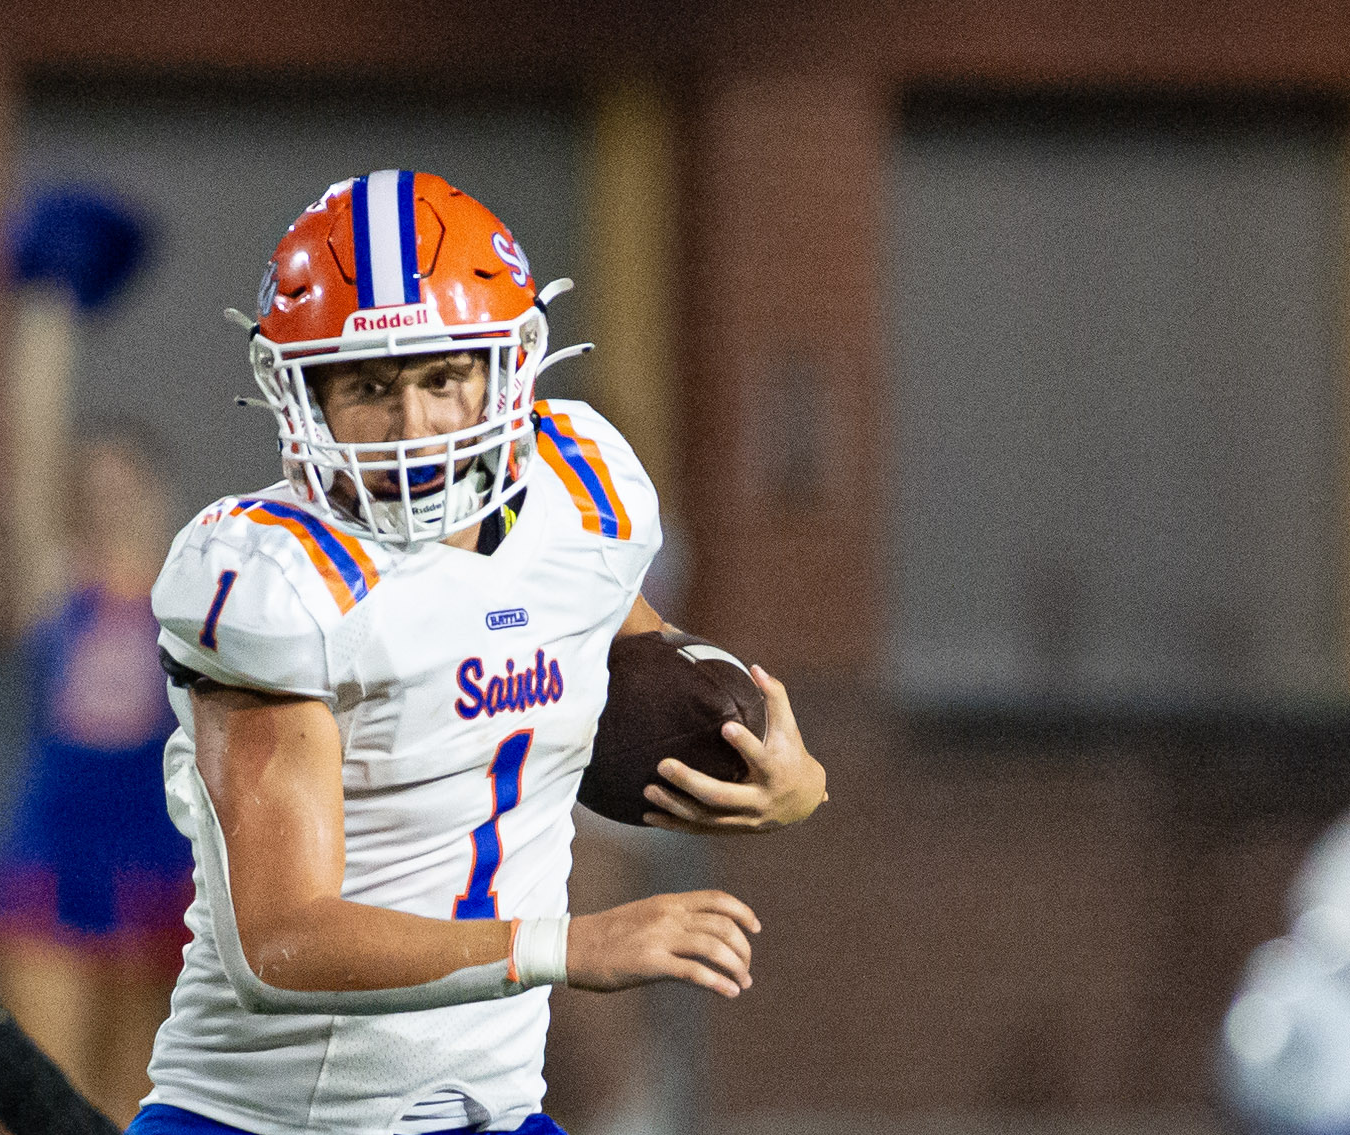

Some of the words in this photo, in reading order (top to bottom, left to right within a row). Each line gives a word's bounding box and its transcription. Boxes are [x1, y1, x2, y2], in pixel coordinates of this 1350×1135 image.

[353, 309, 428, 332] Riddell
[199, 568, 239, 653] 1
[490, 611, 526, 627] BATTLE
[454, 647, 564, 720] Saints
[451, 727, 534, 920] 1
